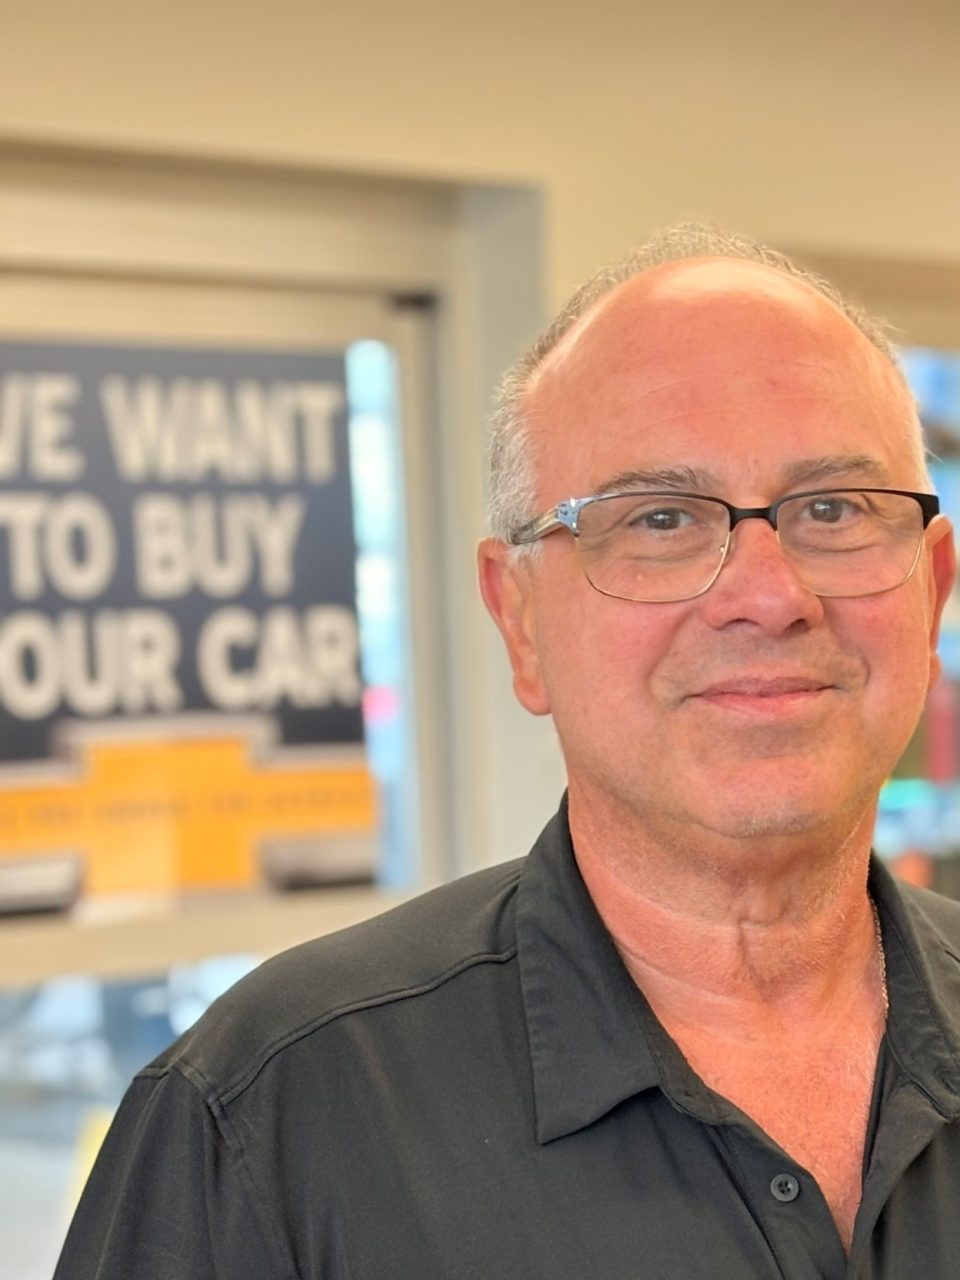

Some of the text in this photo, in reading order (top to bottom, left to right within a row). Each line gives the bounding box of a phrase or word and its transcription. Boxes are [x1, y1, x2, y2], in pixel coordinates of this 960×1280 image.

[102, 375, 344, 485] WANT
[0, 493, 304, 600] TO BUY
[199, 606, 361, 710] CAR
